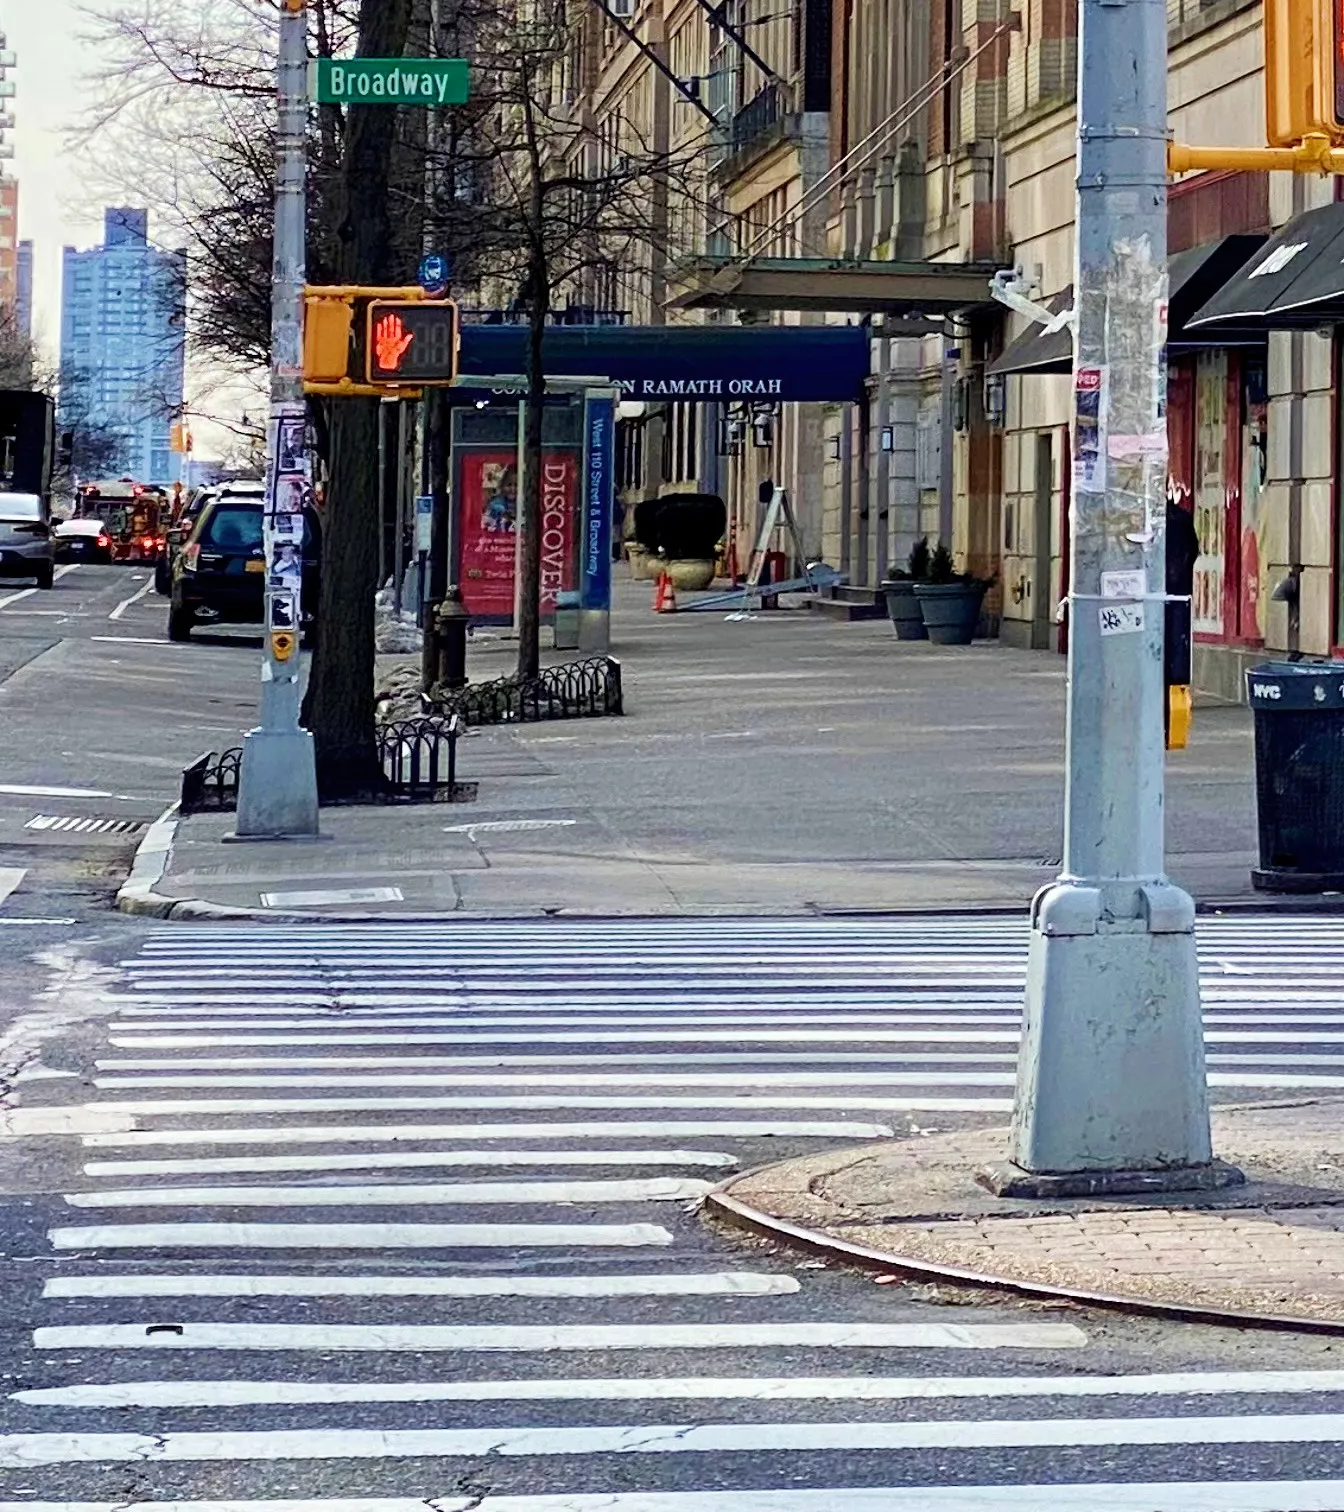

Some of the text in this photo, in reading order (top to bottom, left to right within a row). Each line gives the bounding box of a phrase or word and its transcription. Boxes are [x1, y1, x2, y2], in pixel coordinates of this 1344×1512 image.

[331, 67, 448, 102] Broadway
[643, 379, 724, 394] RAMATH
[729, 378, 782, 394] ORAH
[592, 418, 604, 448] West
[591, 452, 603, 469] 110
[591, 471, 602, 506] Street
[541, 463, 566, 604] DISCOVER
[586, 520, 601, 577] Broadway
[1253, 683, 1281, 700] NYC
